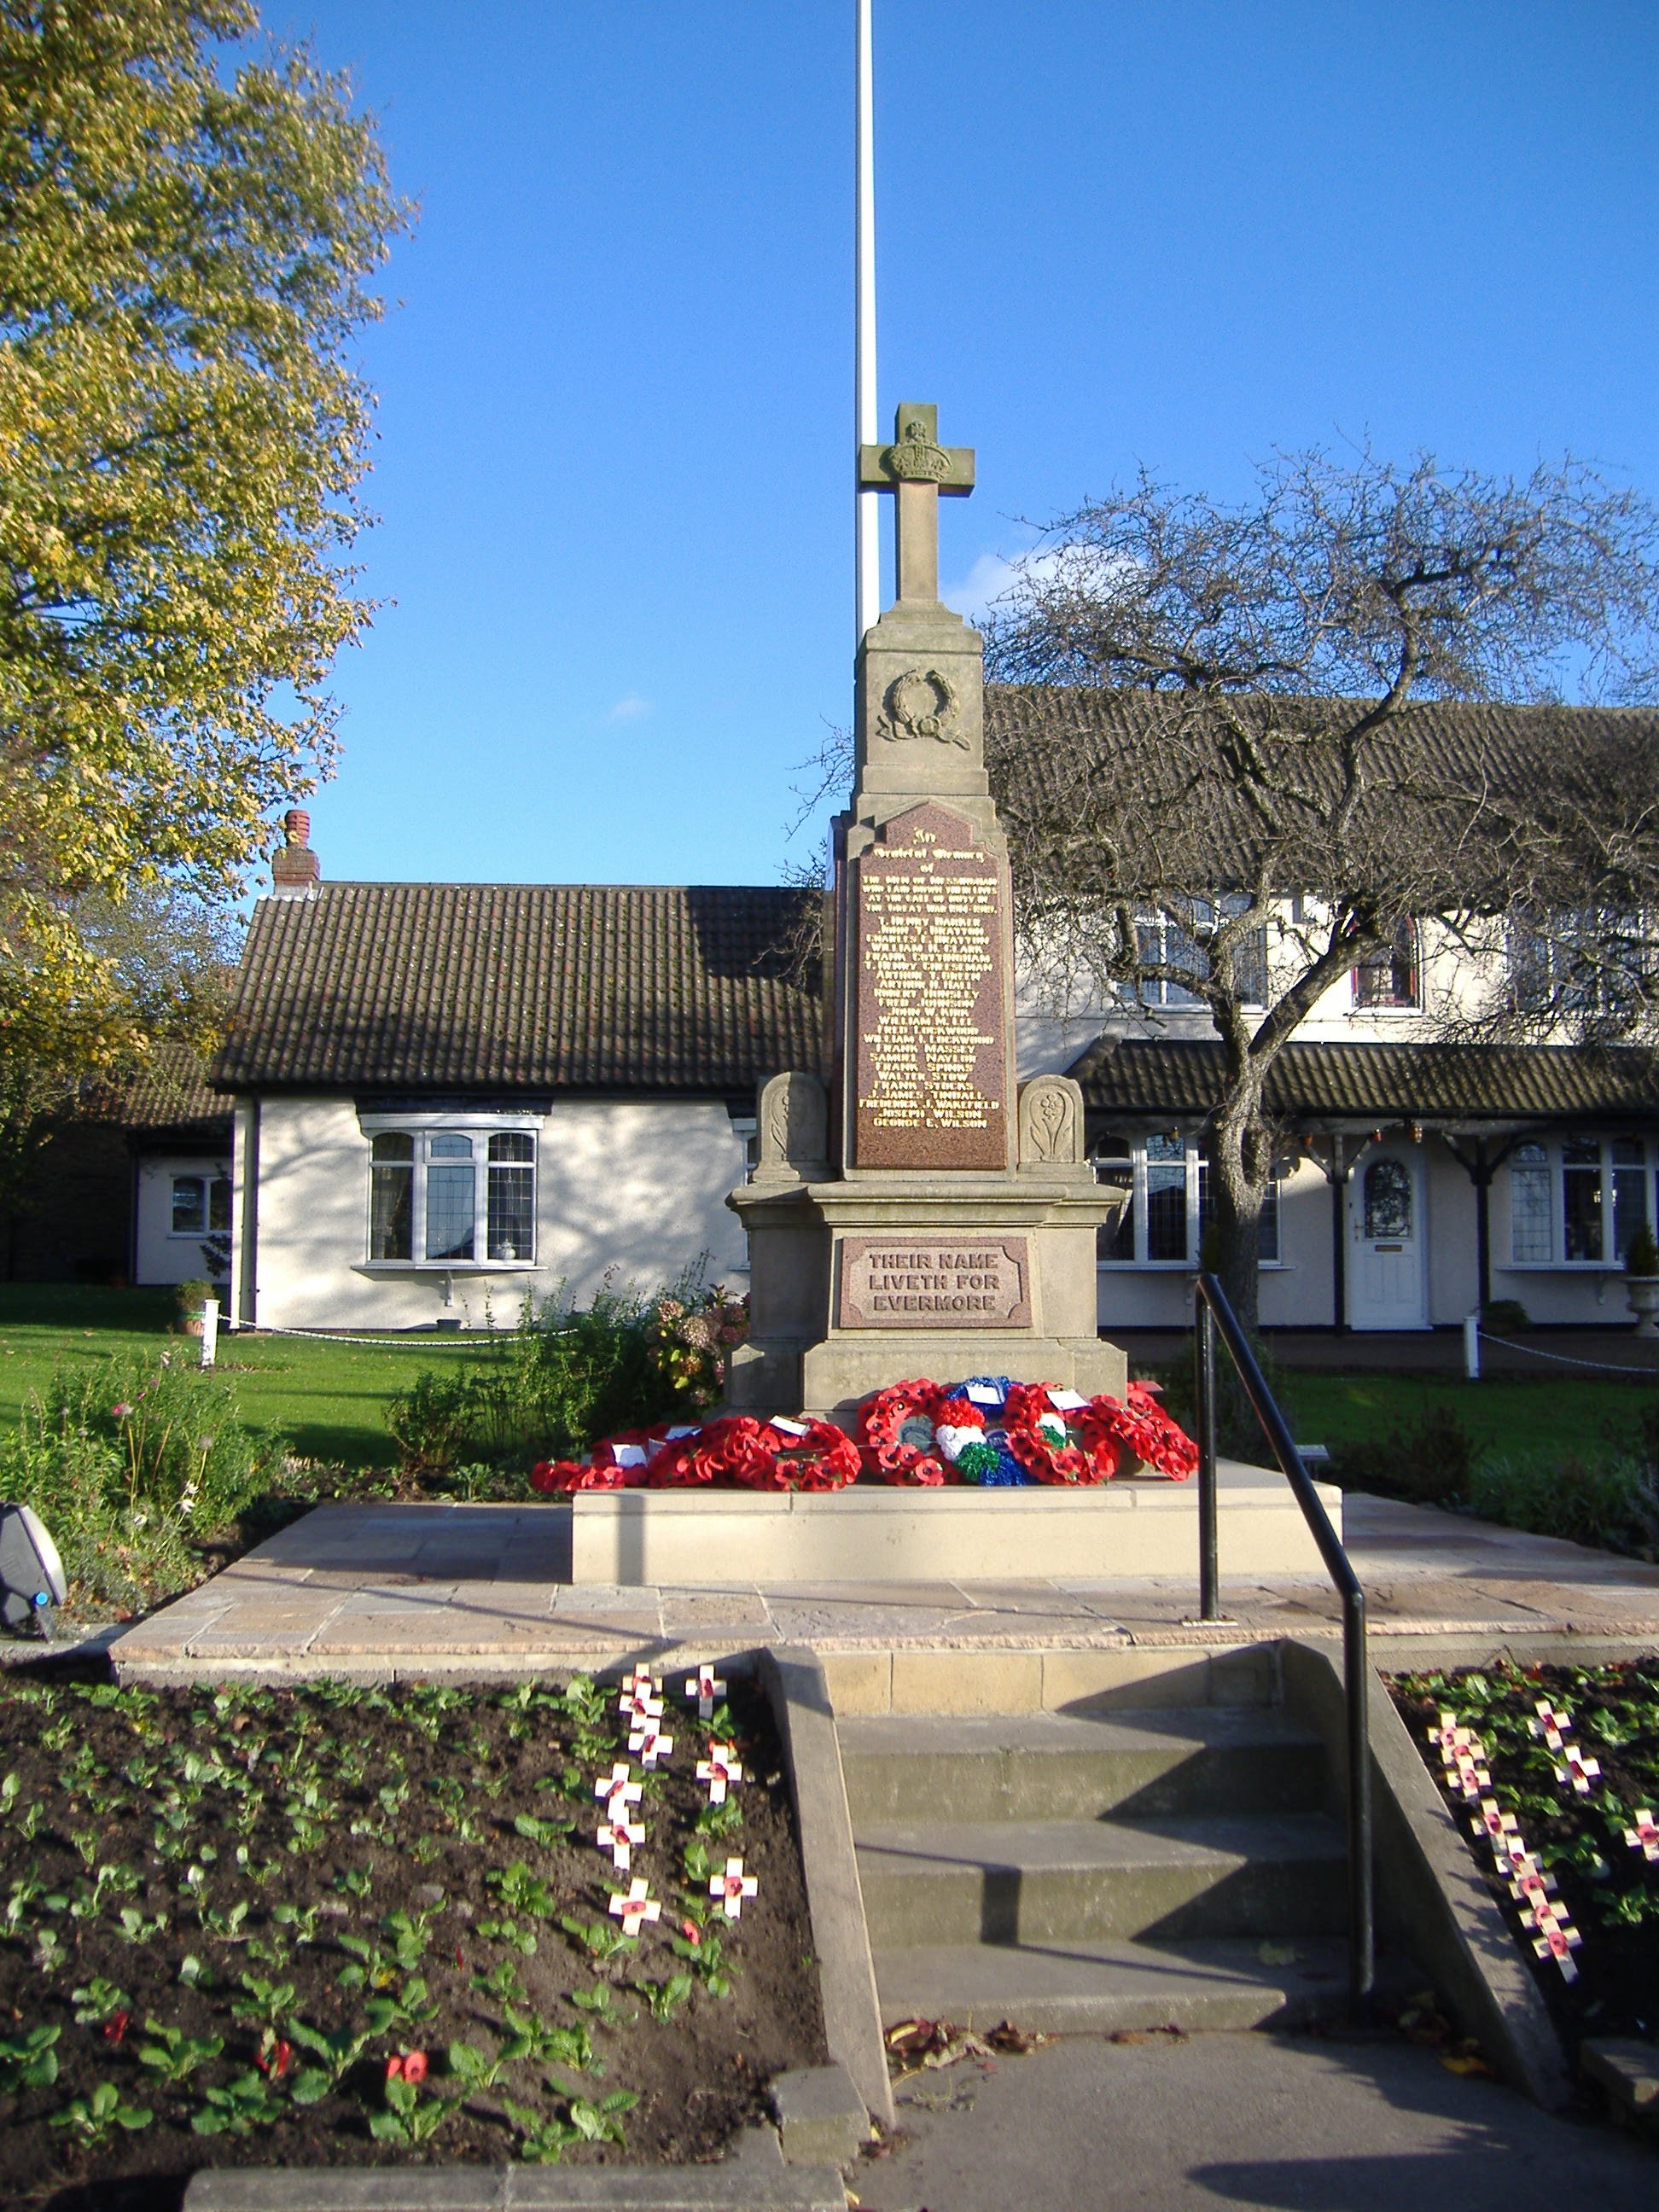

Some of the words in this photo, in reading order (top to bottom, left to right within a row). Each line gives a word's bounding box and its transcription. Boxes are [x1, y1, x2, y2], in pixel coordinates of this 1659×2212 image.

[891, 916, 929, 926] HENRY
[879, 926, 909, 934] JOHN
[871, 943, 923, 952] WILLIAM
[944, 945, 983, 953] CLARK
[866, 952, 905, 961] FRANK
[878, 961, 917, 970] HENRY
[876, 971, 922, 980] ARTHUR
[880, 981, 925, 989] ARTHUR
[917, 998, 975, 1008] JOHNSON
[941, 1008, 969, 1016] KIRK
[879, 1016, 931, 1025] WILLIAM
[877, 1025, 908, 1033] FRED
[914, 1026, 979, 1034] LOCKWOOD
[864, 1034, 914, 1043] WILLIAM
[929, 1035, 994, 1045] LOCKWOOD
[876, 1045, 917, 1053] FRANK
[924, 1045, 975, 1053] MASSEY
[870, 1053, 917, 1062] SAMUEL
[926, 1055, 976, 1063] NAYLOR
[928, 1063, 973, 1072] SPINKS
[878, 1072, 925, 1080] WALTER
[932, 1073, 968, 1081] STOW
[874, 1080, 917, 1090] FRANK
[924, 1081, 974, 1090] STOCKS
[882, 1090, 923, 1098] JAMES
[931, 1091, 984, 1099] TINDALL
[859, 1099, 917, 1108] FREDERICK
[936, 1100, 999, 1109] WAKEFIELD
[879, 1109, 924, 1117] JOSEPH
[873, 1118, 920, 1126] GEORGE
[940, 1119, 987, 1128] WILSON
[870, 1254, 933, 1269] THEIR
[939, 1254, 998, 1269] NAME
[870, 1275, 946, 1289] LIVETH
[958, 1275, 999, 1289] FOR
[874, 1295, 996, 1311] EVERMORE
